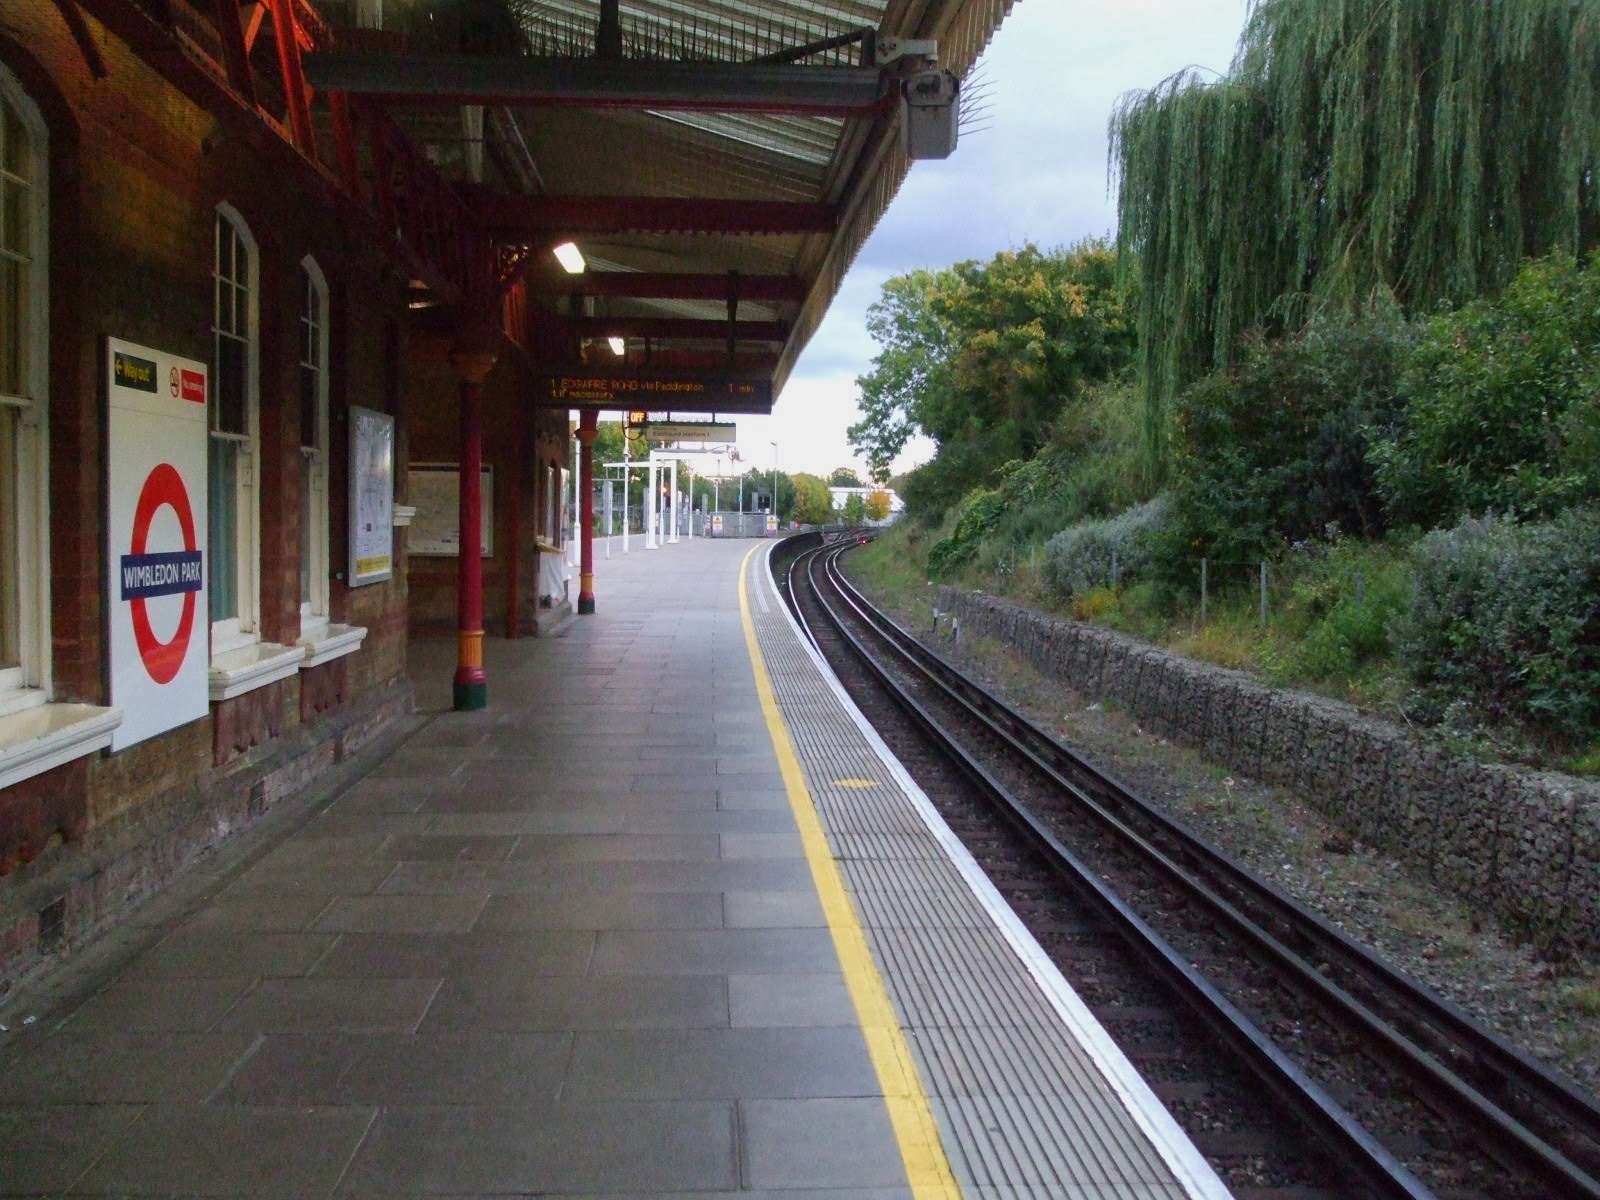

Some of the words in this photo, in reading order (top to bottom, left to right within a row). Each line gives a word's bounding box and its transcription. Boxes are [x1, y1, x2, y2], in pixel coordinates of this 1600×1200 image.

[656, 381, 704, 393] Paddington
[739, 384, 754, 394] min
[630, 412, 645, 423] OFF
[124, 563, 179, 589] WIMBLEDON
[181, 562, 201, 582] PARK
